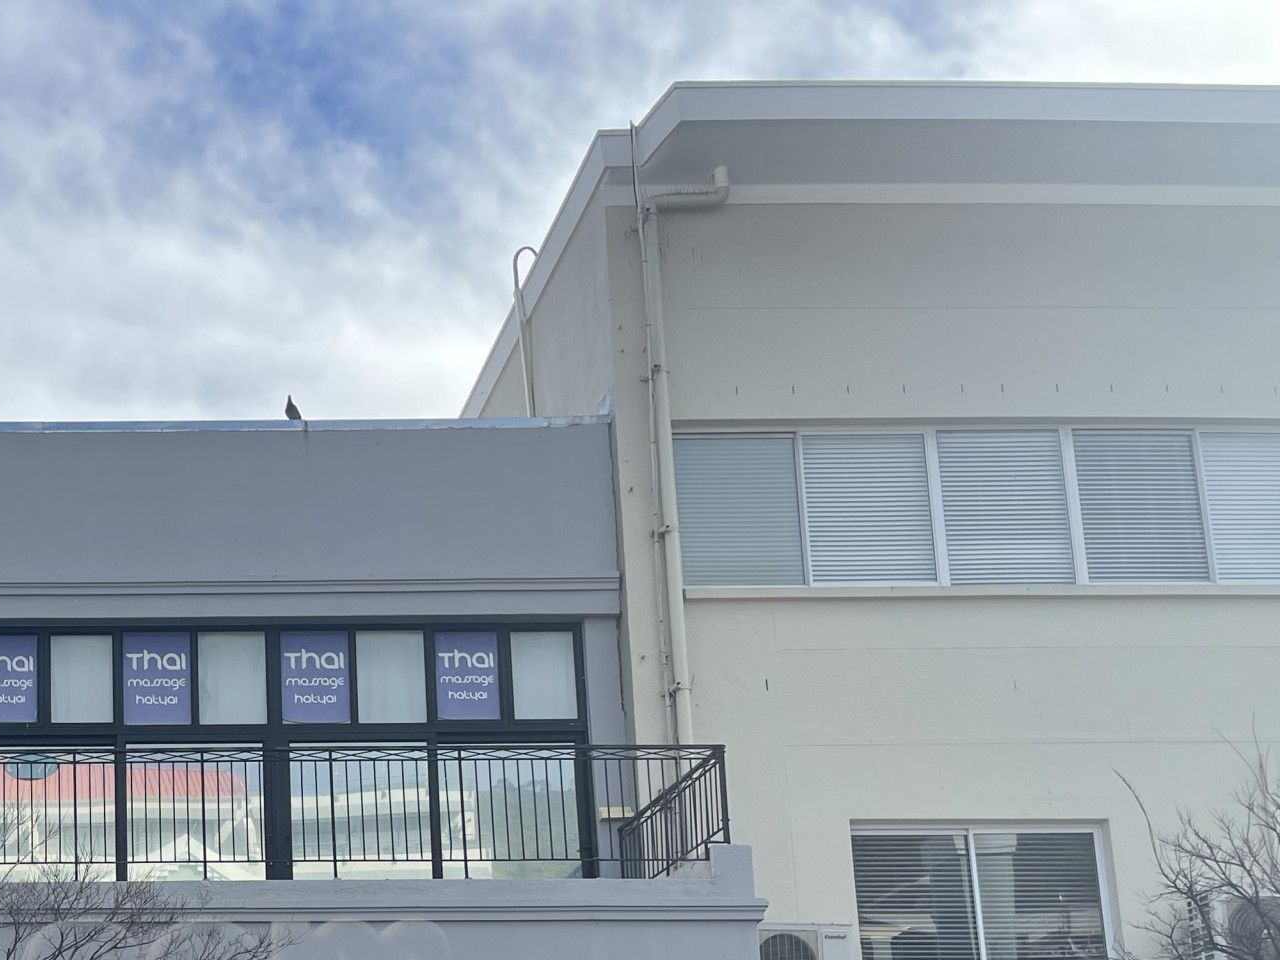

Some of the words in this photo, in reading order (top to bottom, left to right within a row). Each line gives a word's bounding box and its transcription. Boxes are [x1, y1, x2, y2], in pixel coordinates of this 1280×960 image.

[126, 649, 186, 671] Thai
[283, 648, 345, 670] Thai
[437, 649, 495, 668] Thai
[127, 678, 186, 690] massage
[285, 677, 345, 690] massage
[440, 675, 495, 687] massage
[135, 694, 178, 706] hatyai
[294, 693, 337, 705] hatyai
[448, 690, 488, 701] hatyai
